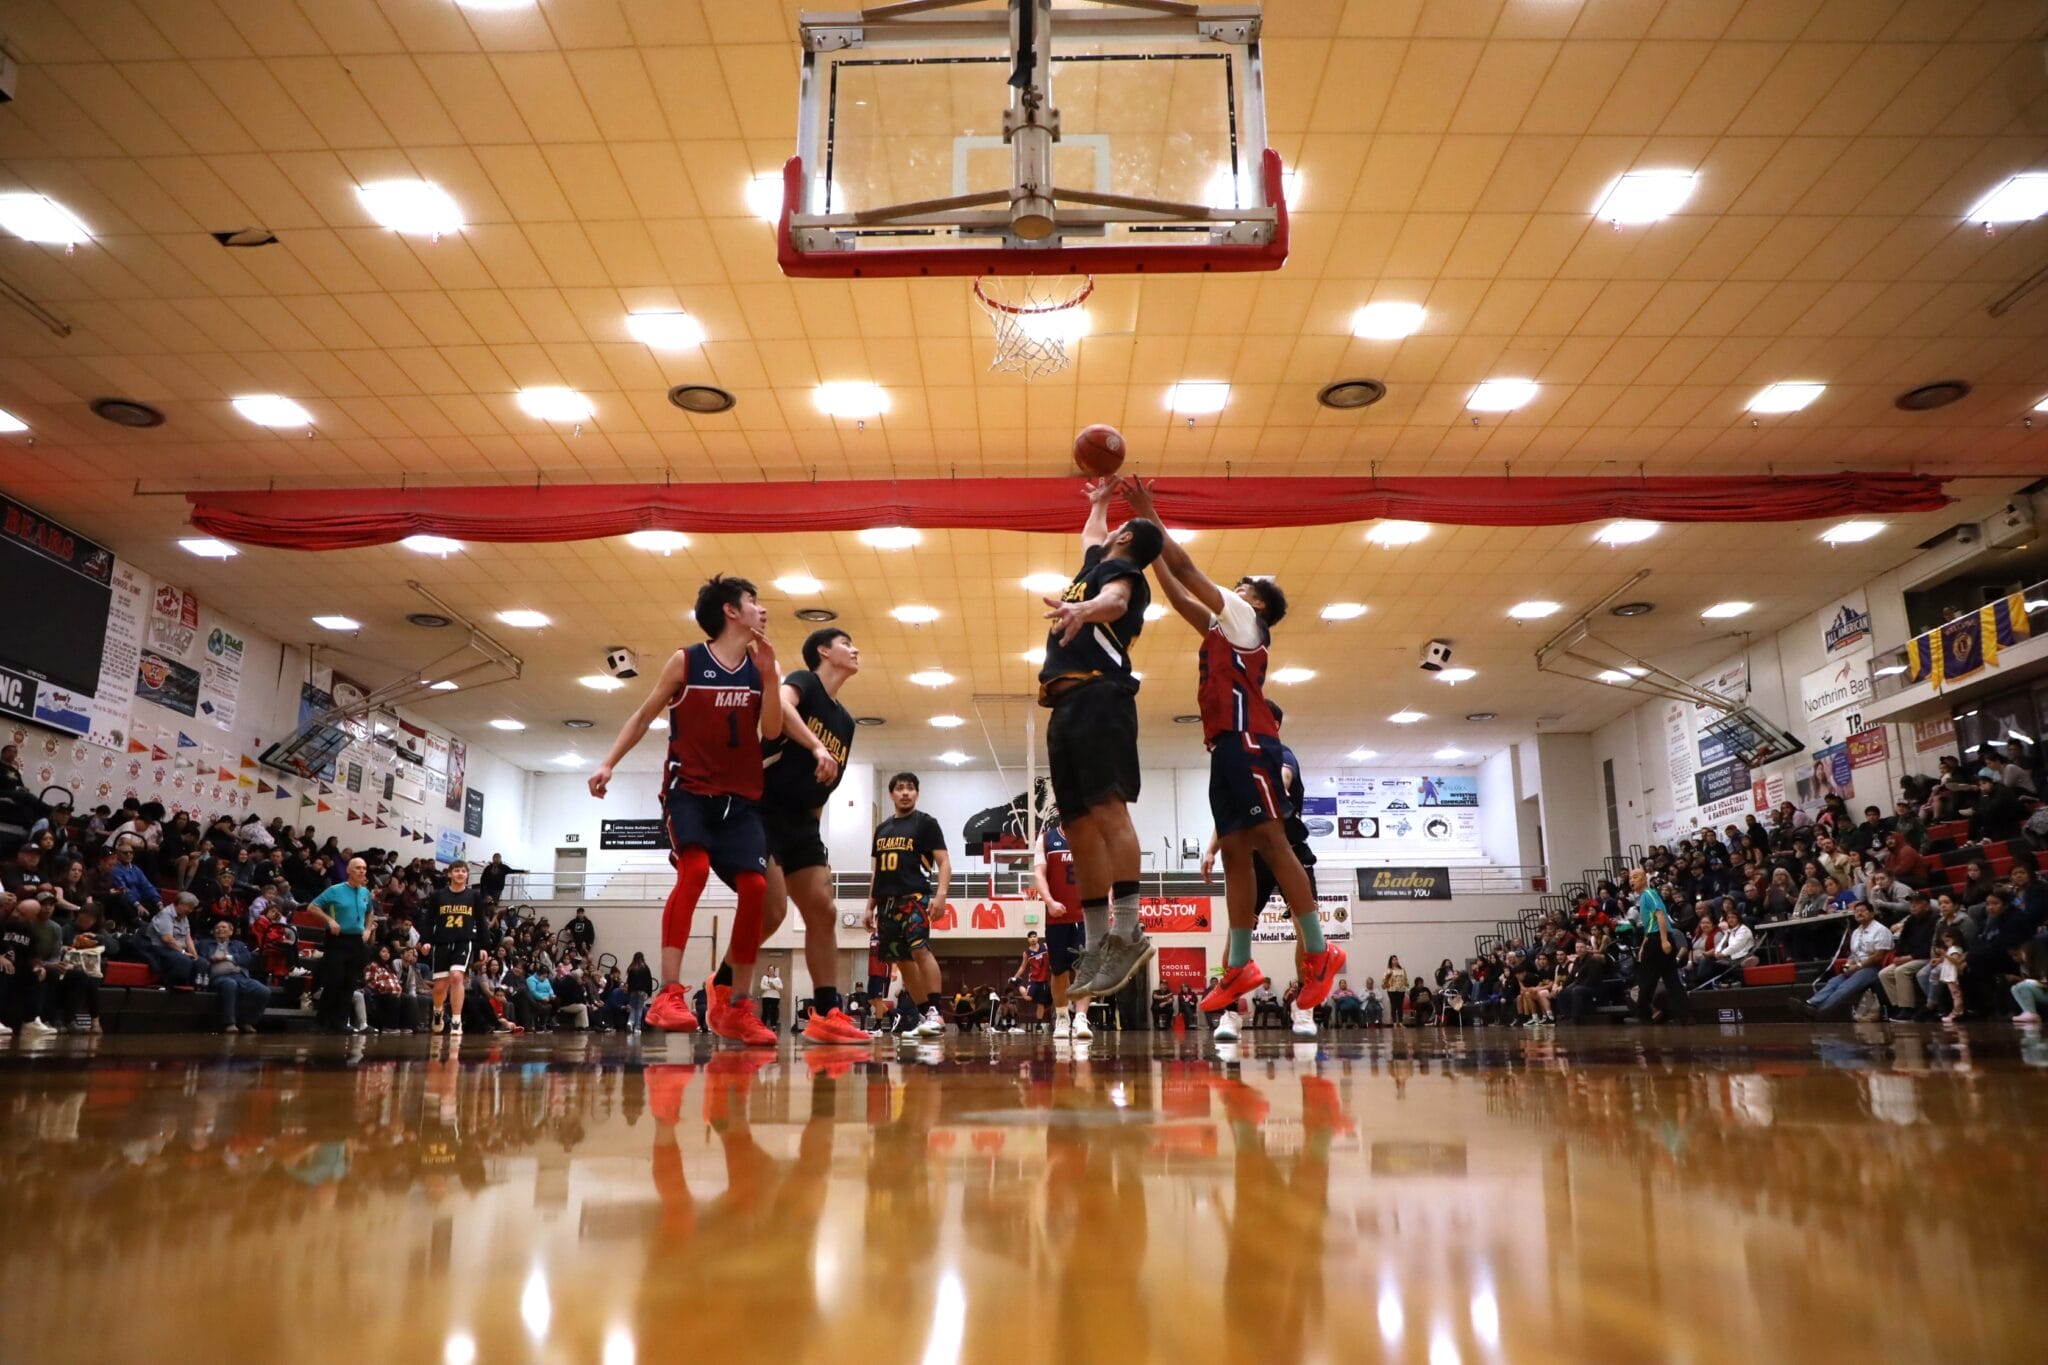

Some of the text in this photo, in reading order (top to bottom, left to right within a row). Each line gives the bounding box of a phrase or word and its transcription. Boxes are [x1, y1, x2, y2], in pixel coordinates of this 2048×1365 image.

[4, 506, 75, 561] BEARS
[715, 692, 750, 707] KAKE
[1804, 677, 1872, 714] Northrim Ban
[727, 711, 739, 747] 1
[1703, 794, 1748, 814] GIRLS VOLLEYBALL
[880, 852, 899, 871] 10
[1061, 852, 1074, 862] KA
[1372, 871, 1436, 888] Baden
[1414, 888, 1431, 898] YOU
[1139, 904, 1197, 917] HOUSTON
[1262, 912, 1287, 923] THA
[445, 915, 463, 928] 24
[1261, 933, 1279, 941] Medal
